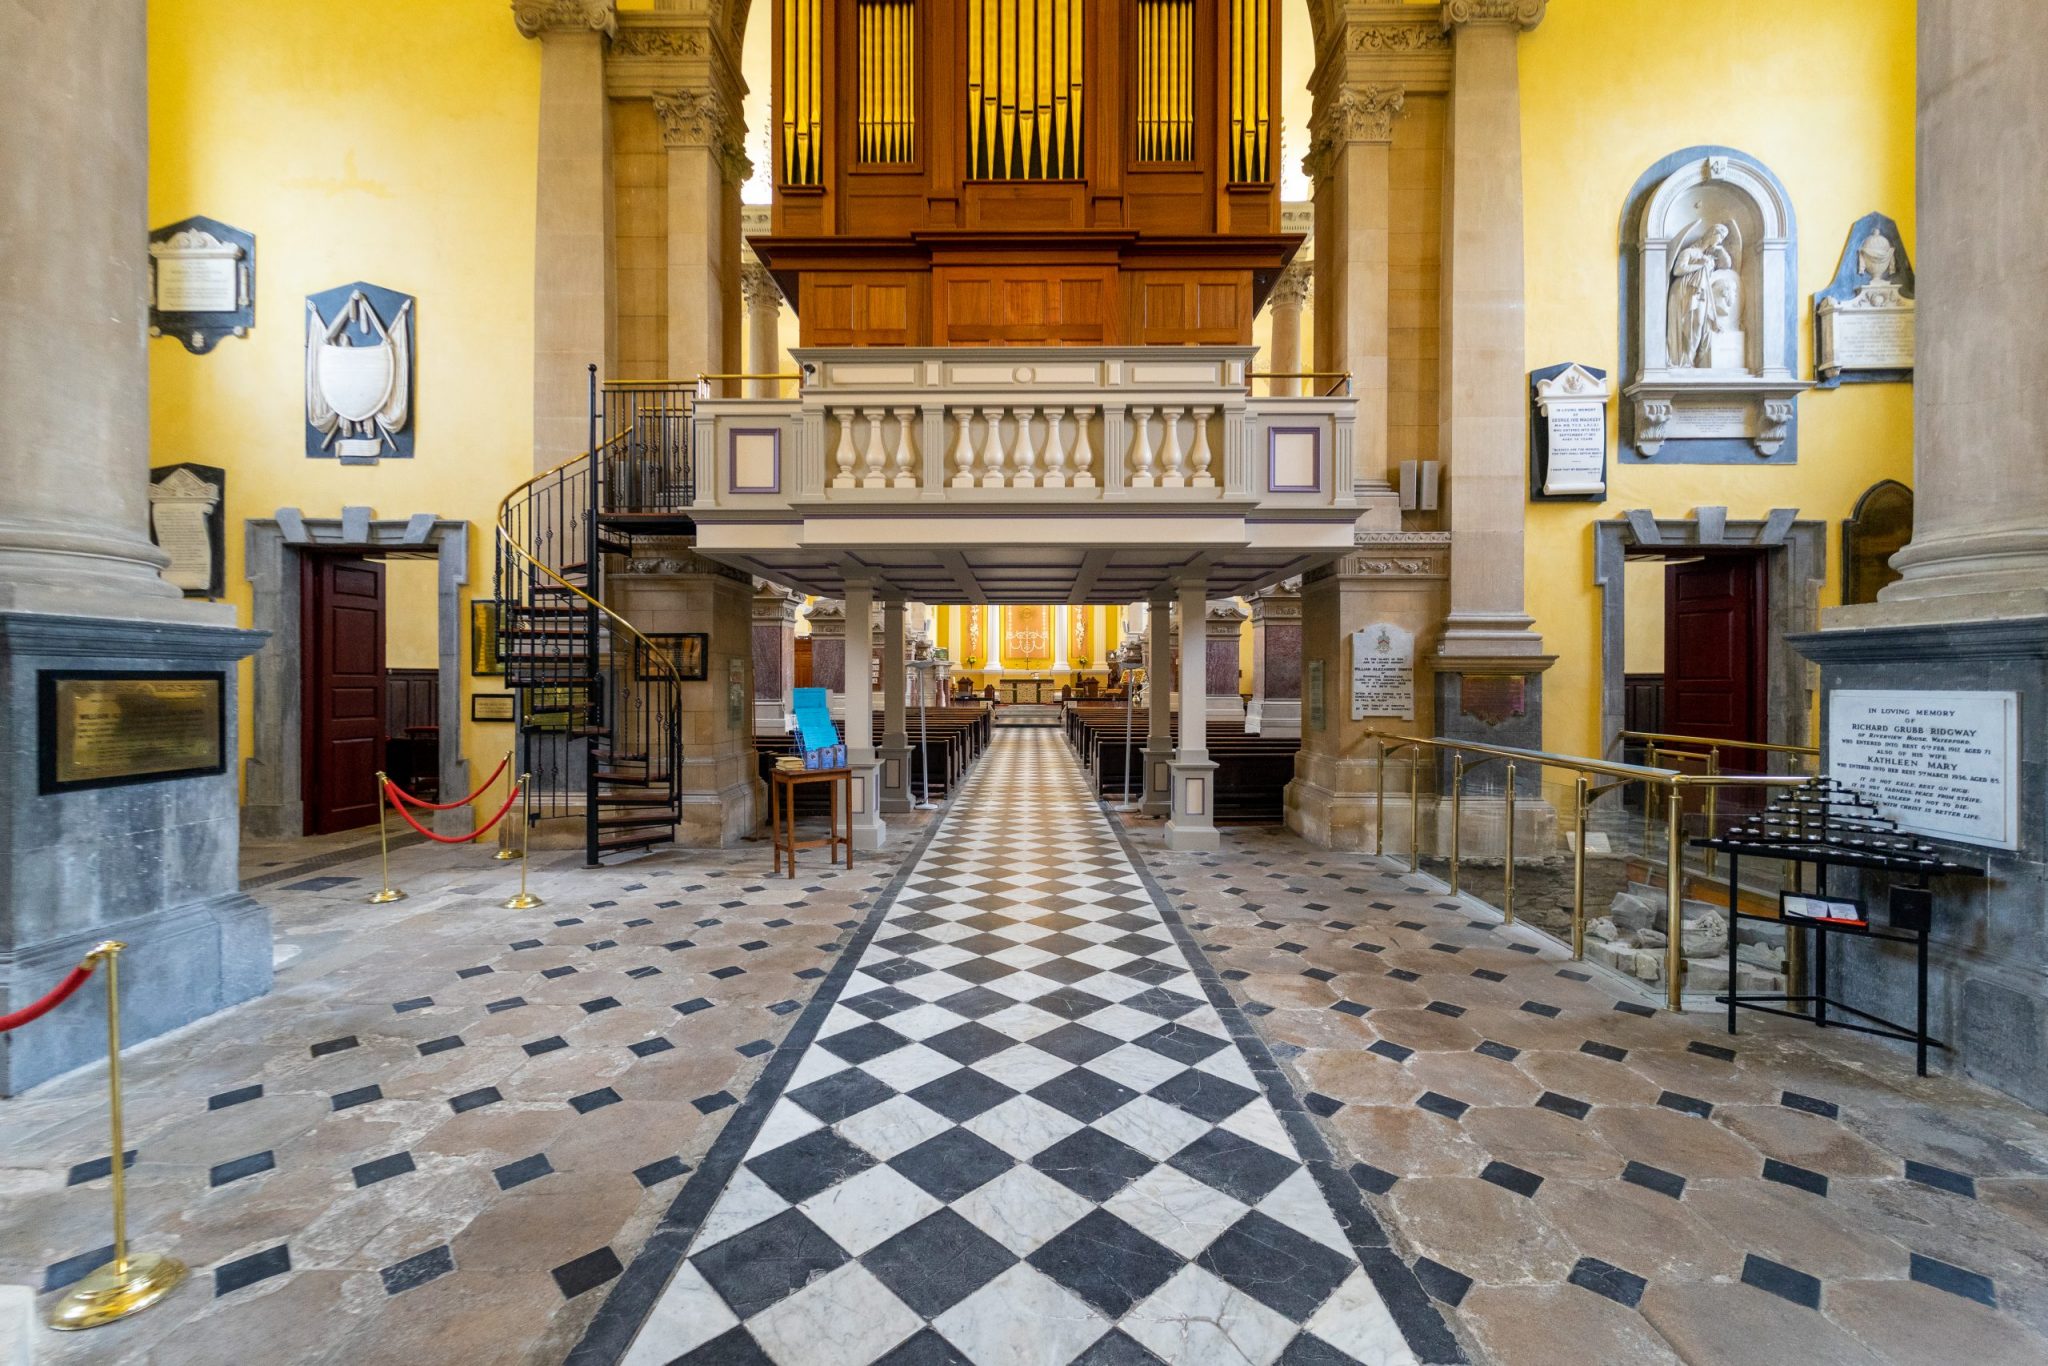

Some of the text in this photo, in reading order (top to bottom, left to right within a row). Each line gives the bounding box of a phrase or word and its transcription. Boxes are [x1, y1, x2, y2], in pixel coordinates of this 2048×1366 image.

[1916, 709, 1956, 717] MEMORY
[1851, 723, 1977, 737] RICHARD GRUBB RIDGWAY
[1867, 755, 1958, 771] KATHLEEN MARY
